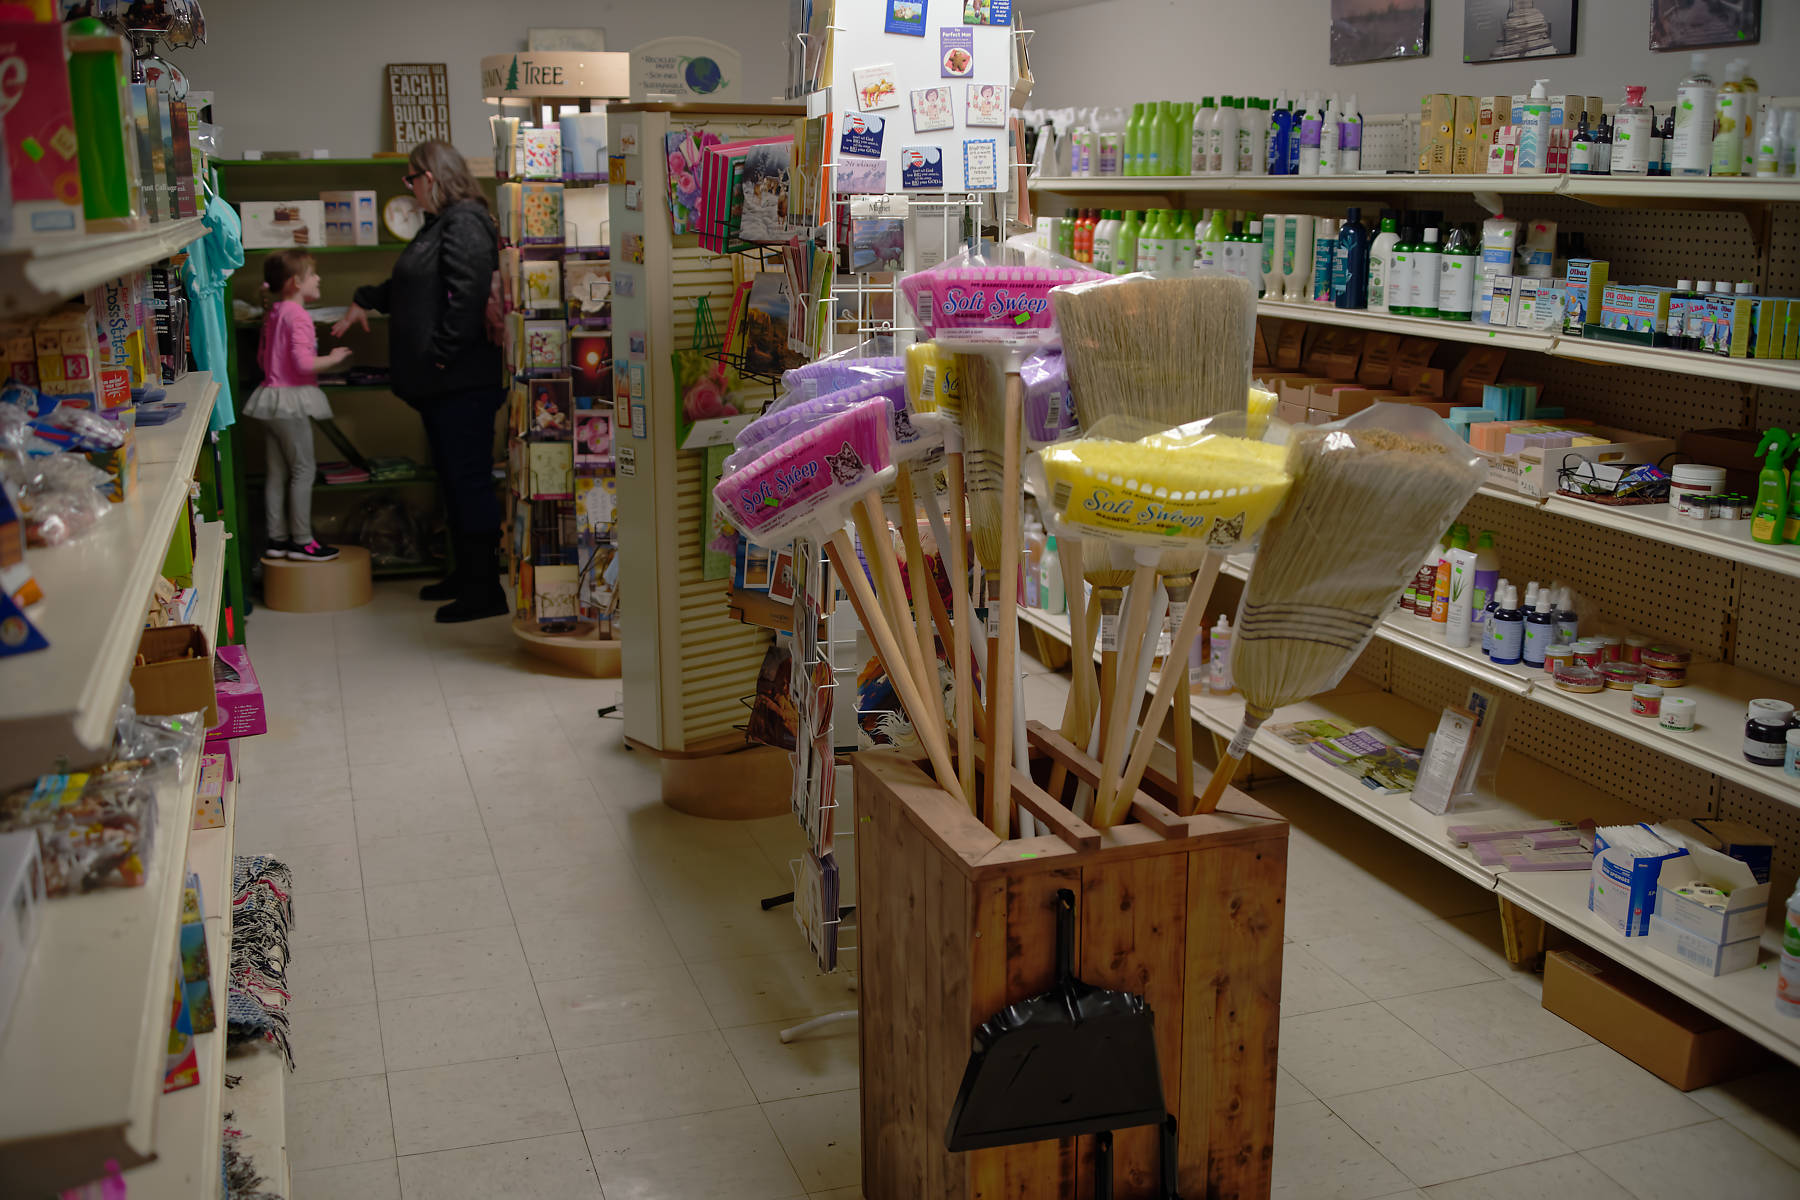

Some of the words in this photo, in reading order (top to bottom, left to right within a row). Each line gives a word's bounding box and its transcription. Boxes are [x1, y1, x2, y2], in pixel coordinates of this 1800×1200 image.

[390, 75, 433, 96] EACH
[522, 61, 565, 86] TREE
[393, 105, 435, 122] BUILD
[395, 122, 437, 143] EACH
[943, 288, 986, 314] Soft
[989, 288, 1048, 314] Sweep
[774, 460, 819, 496] Sweep
[1083, 489, 1134, 514] Soft
[1137, 502, 1205, 528] Sweep
